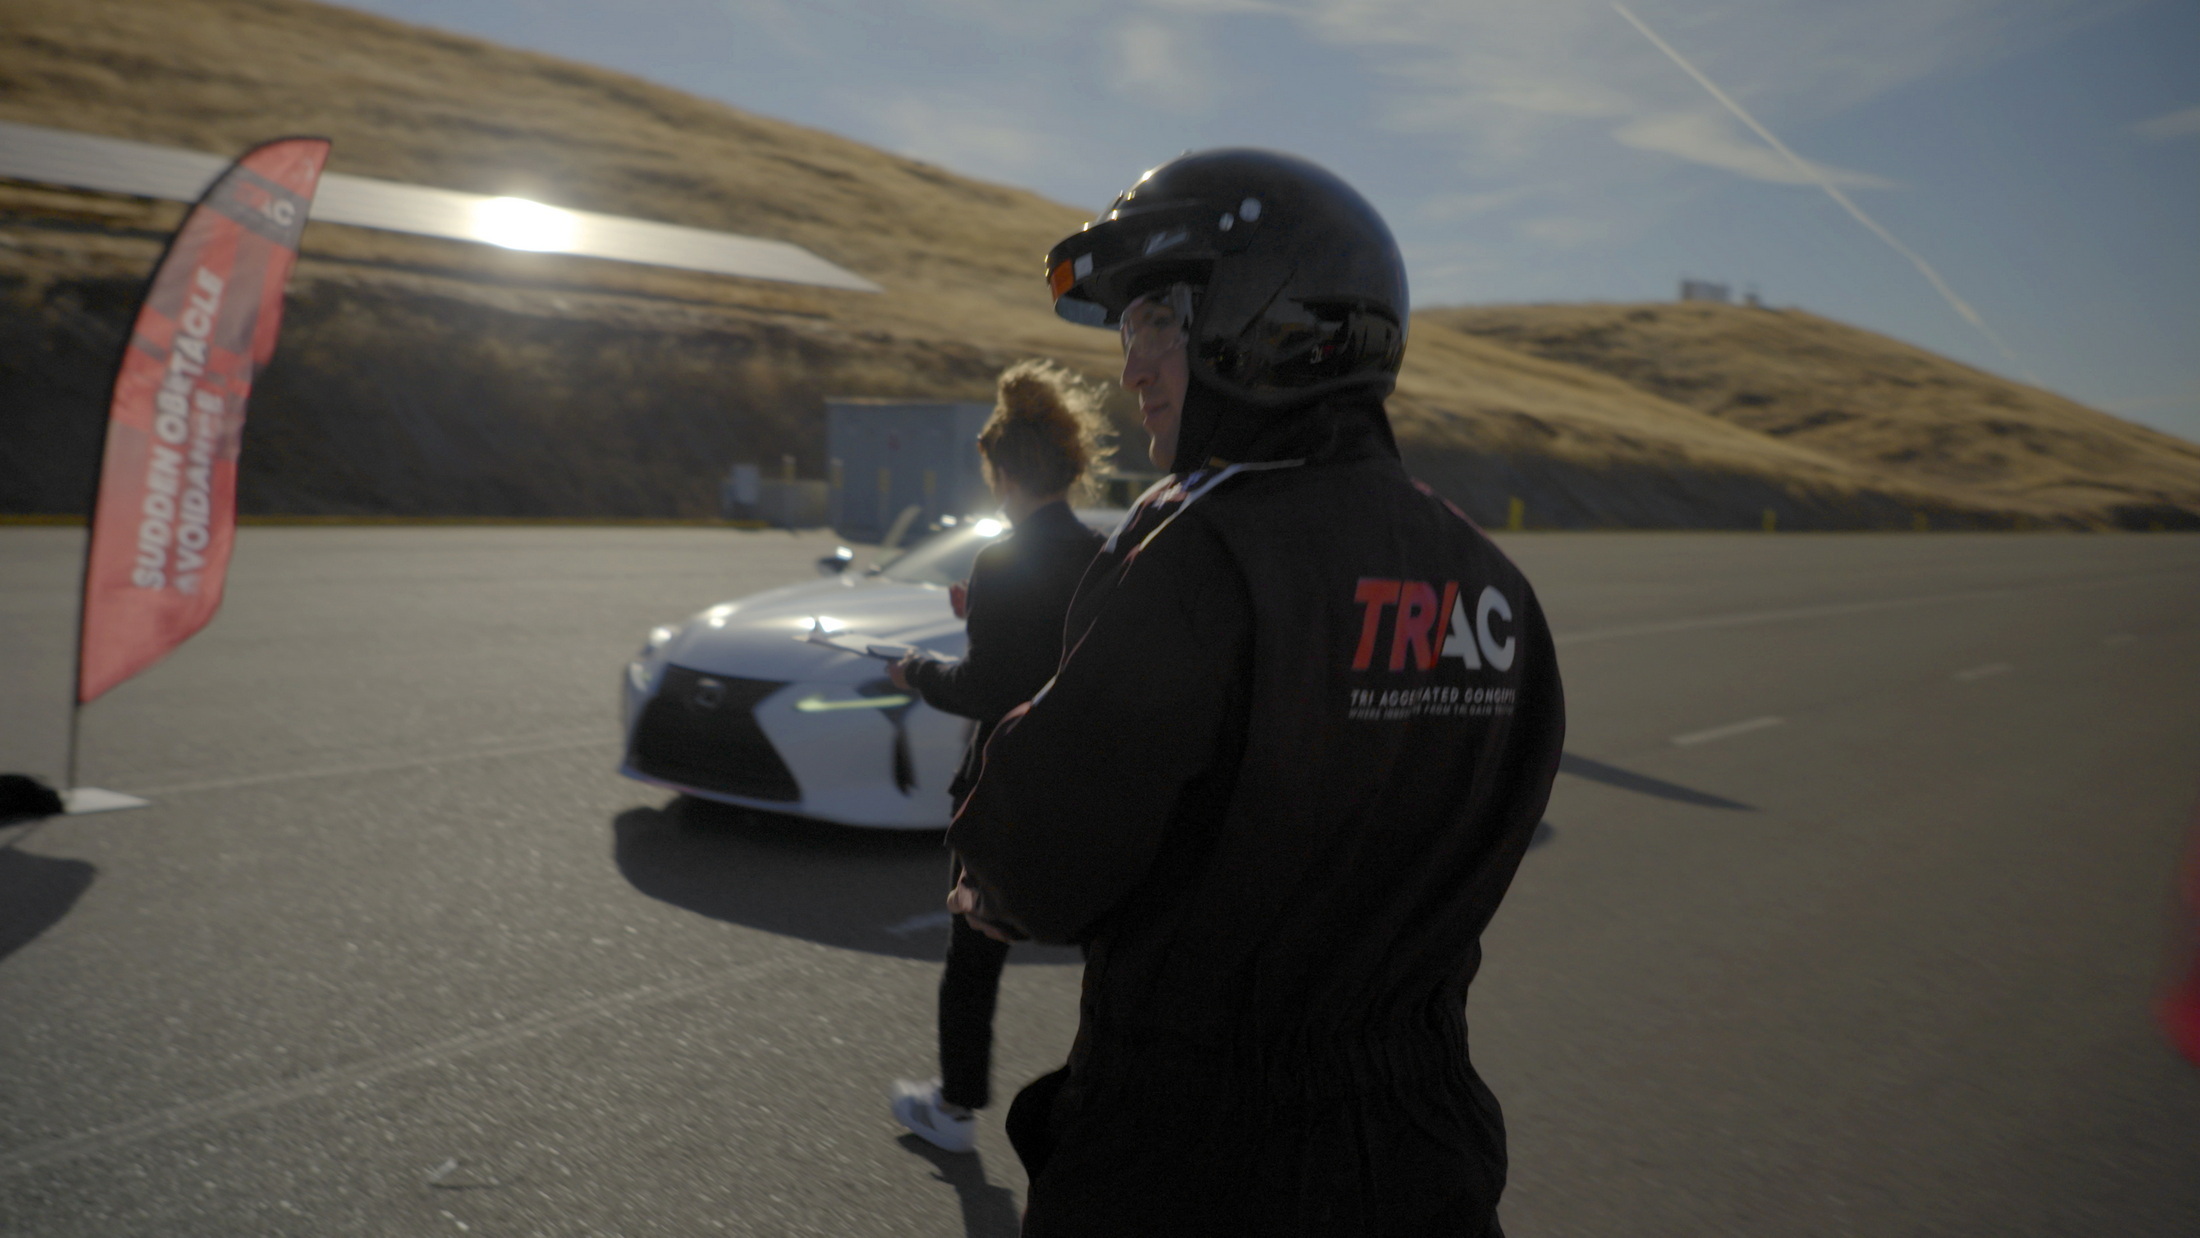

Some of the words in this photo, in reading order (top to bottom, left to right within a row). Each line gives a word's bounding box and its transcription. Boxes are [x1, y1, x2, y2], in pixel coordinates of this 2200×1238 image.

[132, 446, 183, 591] SUDDEN
[1351, 577, 1516, 672] TRIAC
[1351, 689, 1374, 707] TRI
